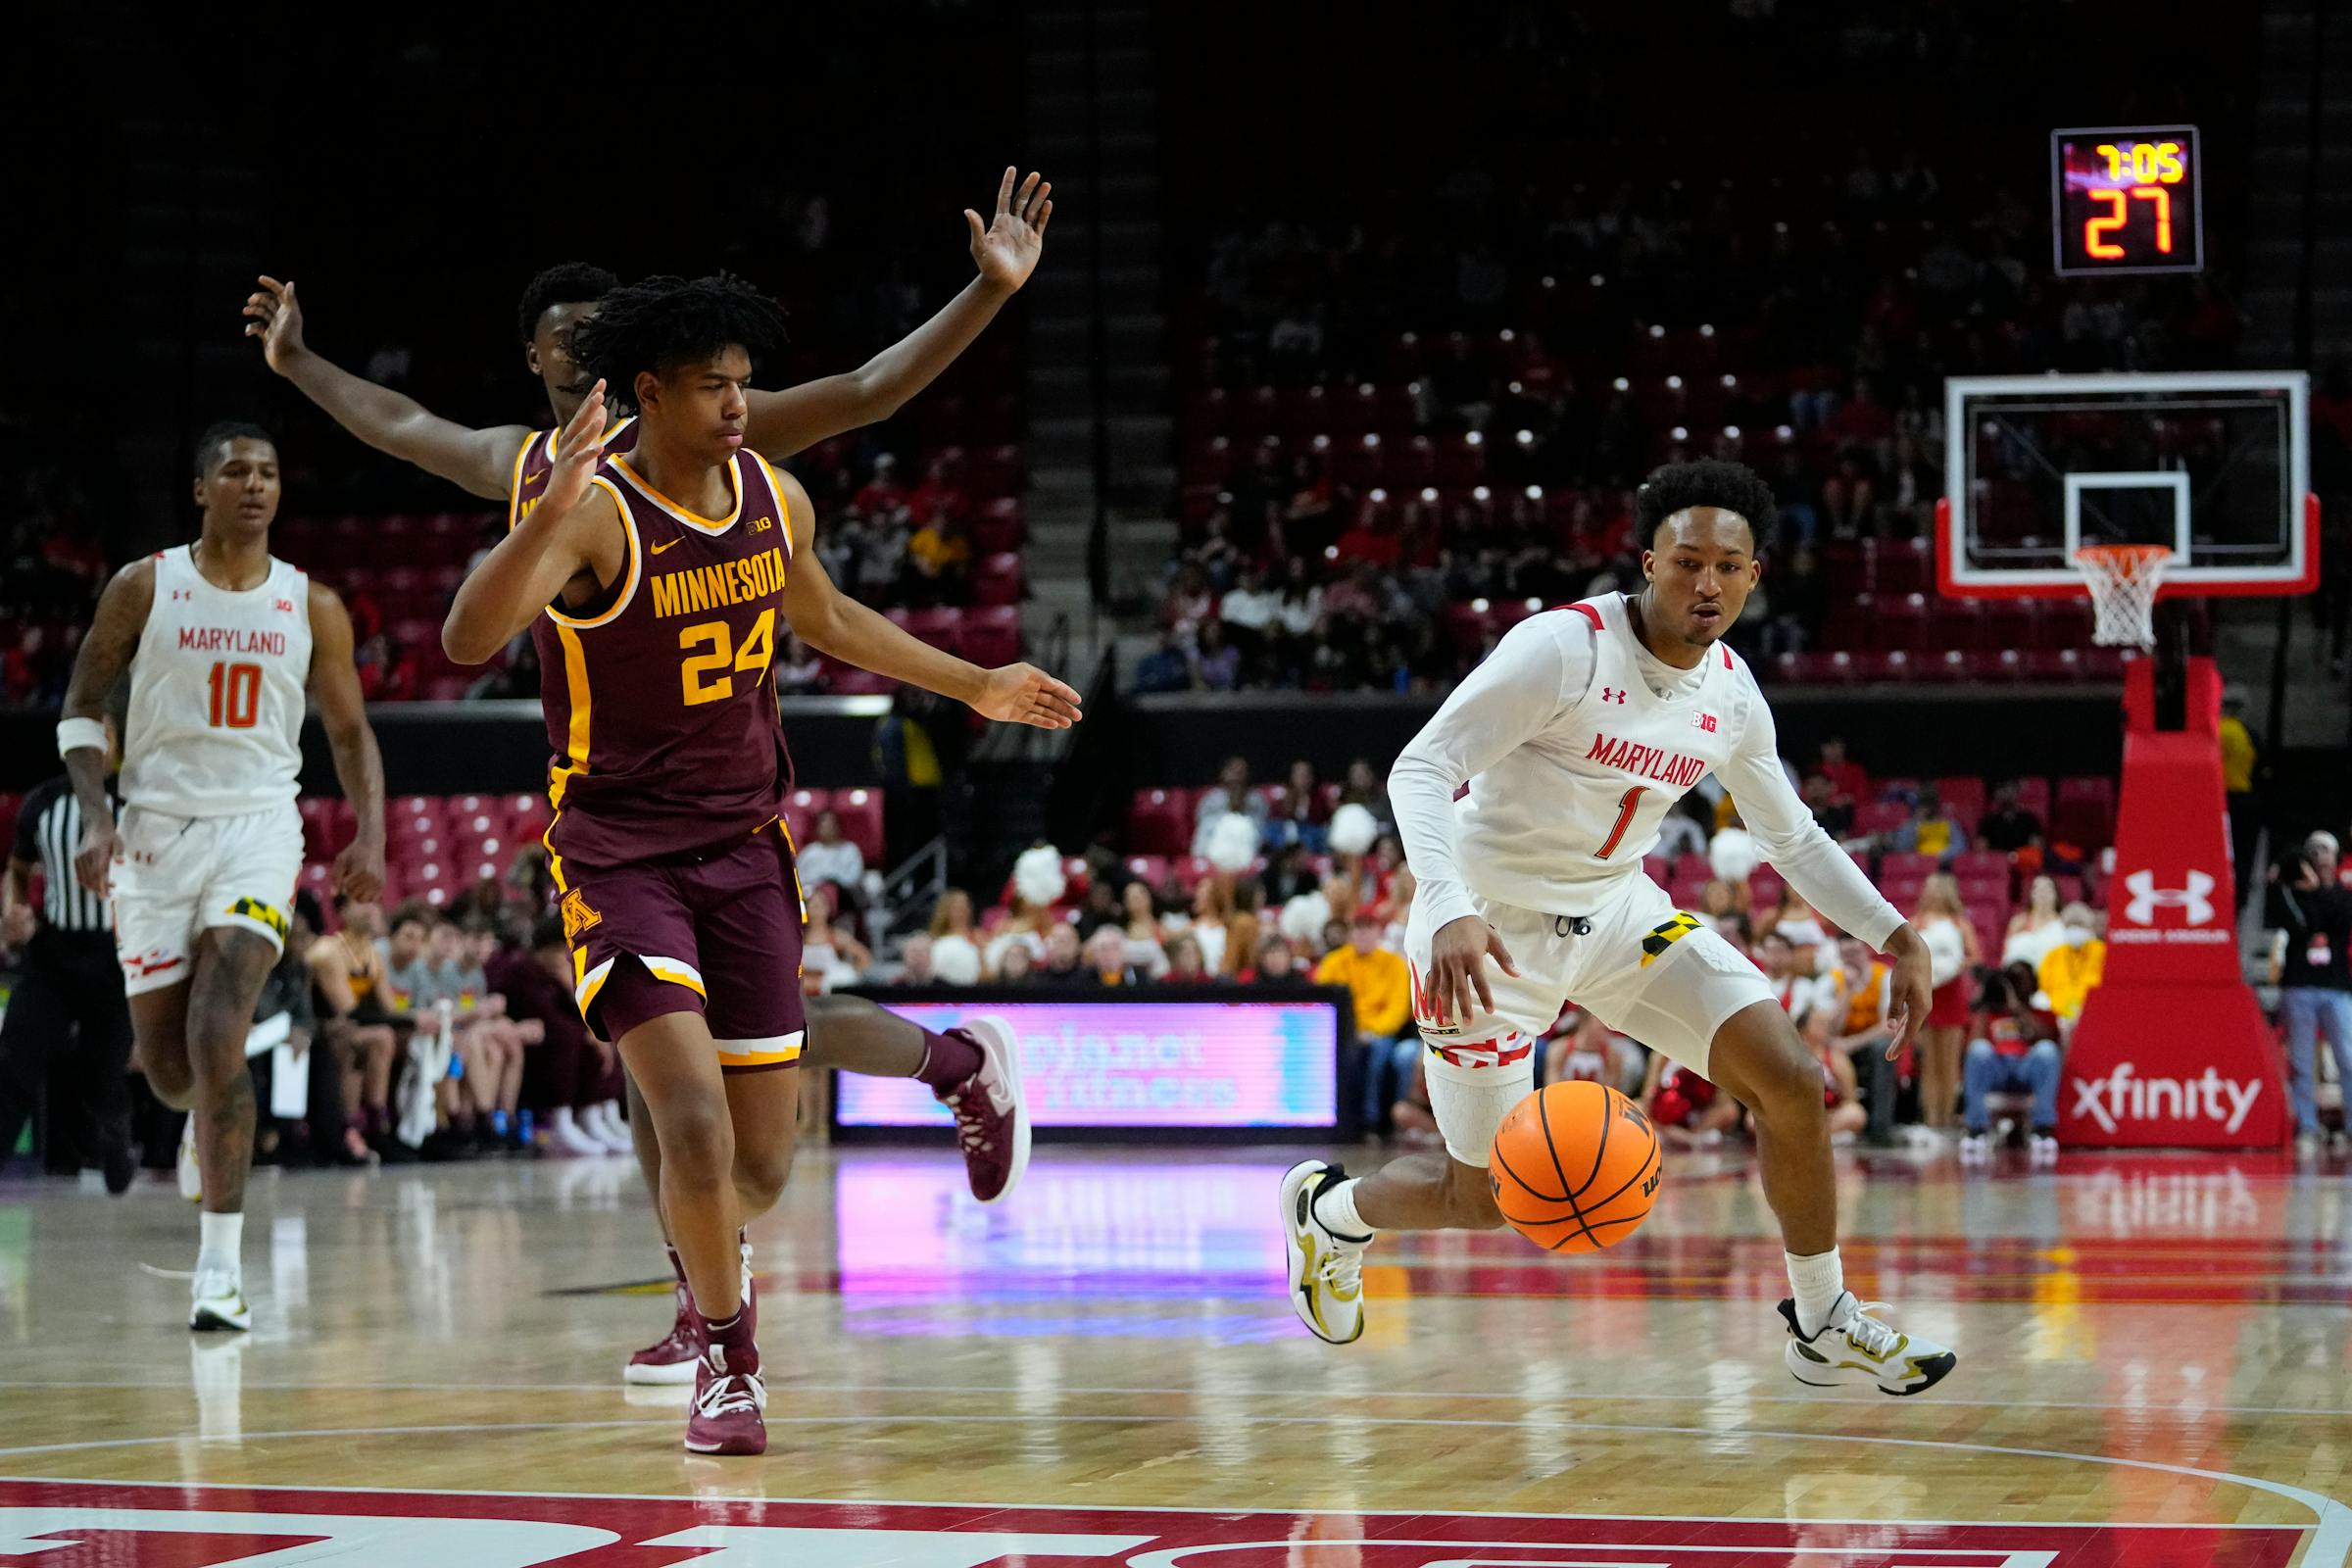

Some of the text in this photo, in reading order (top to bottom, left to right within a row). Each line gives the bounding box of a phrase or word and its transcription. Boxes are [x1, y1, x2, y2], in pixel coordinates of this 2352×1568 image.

[2096, 143, 2183, 183] 7:05
[2085, 187, 2172, 259] 27
[650, 547, 786, 618] MINNESOTA
[178, 626, 286, 656] MARYLAND
[679, 608, 775, 706] 24
[209, 662, 263, 728] 10
[1585, 733, 1705, 787] MARYLAND
[1593, 785, 1650, 860] 1
[2072, 1062, 2262, 1134] xfinity
